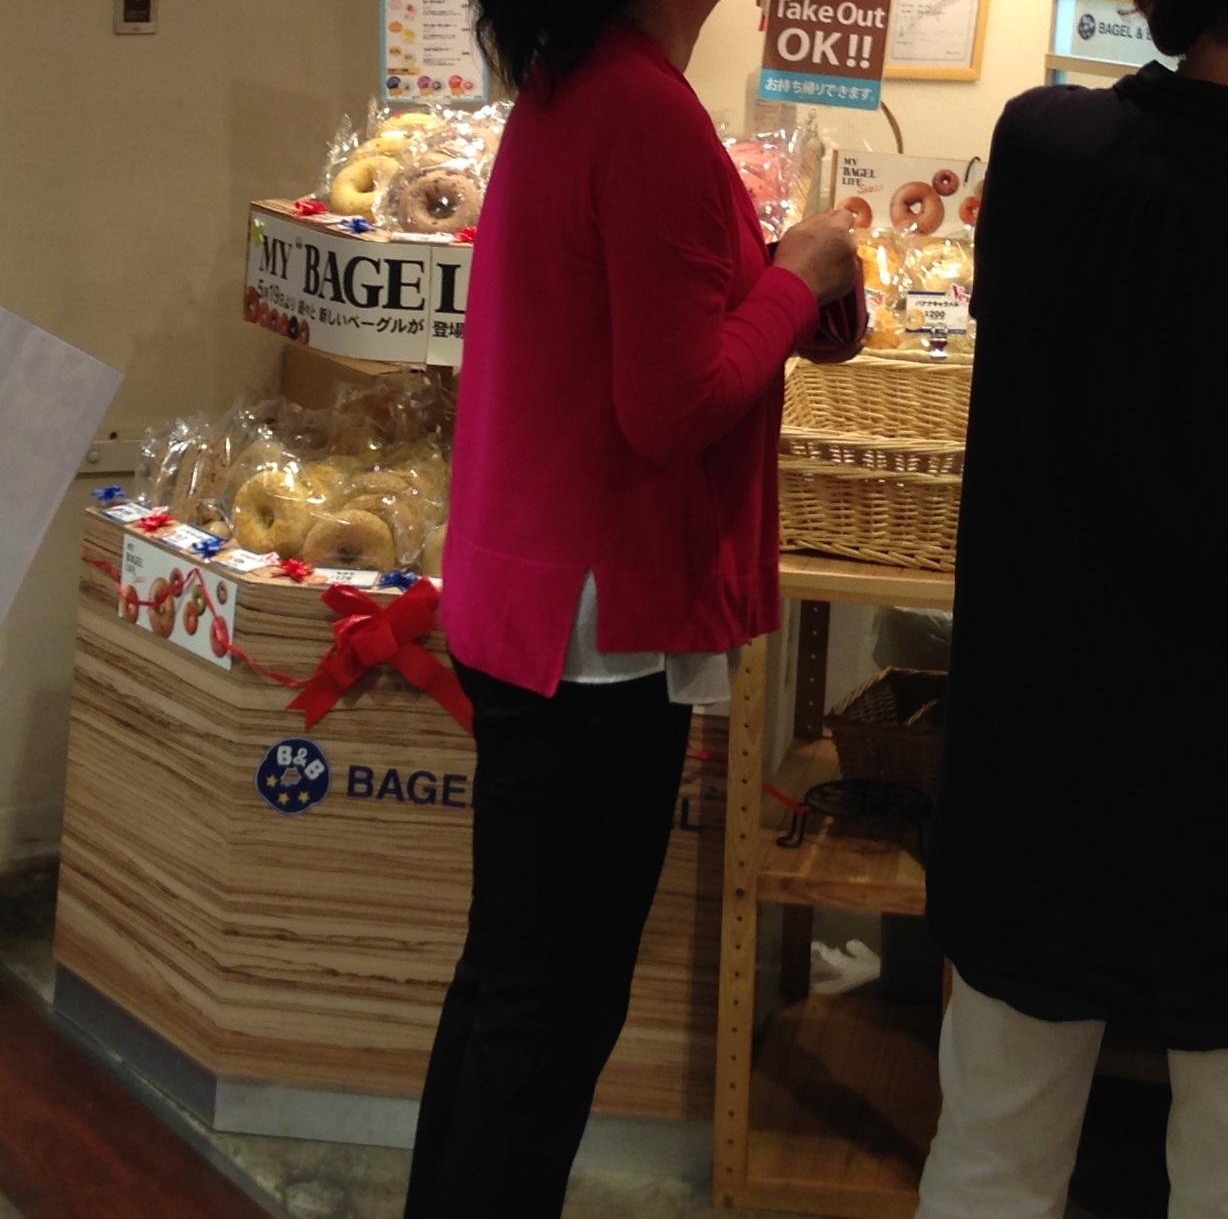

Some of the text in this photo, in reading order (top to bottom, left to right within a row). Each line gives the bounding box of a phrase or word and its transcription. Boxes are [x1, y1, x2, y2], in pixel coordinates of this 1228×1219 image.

[836, 2, 887, 29] Out
[1098, 21, 1133, 39] BAGEL
[776, 26, 874, 70] OK!!
[842, 166, 878, 179] BAGEL
[844, 157, 859, 167] MY
[259, 235, 293, 280] MY
[319, 307, 425, 335] 新しいベーグルが
[276, 744, 469, 809] B&B BAGE
